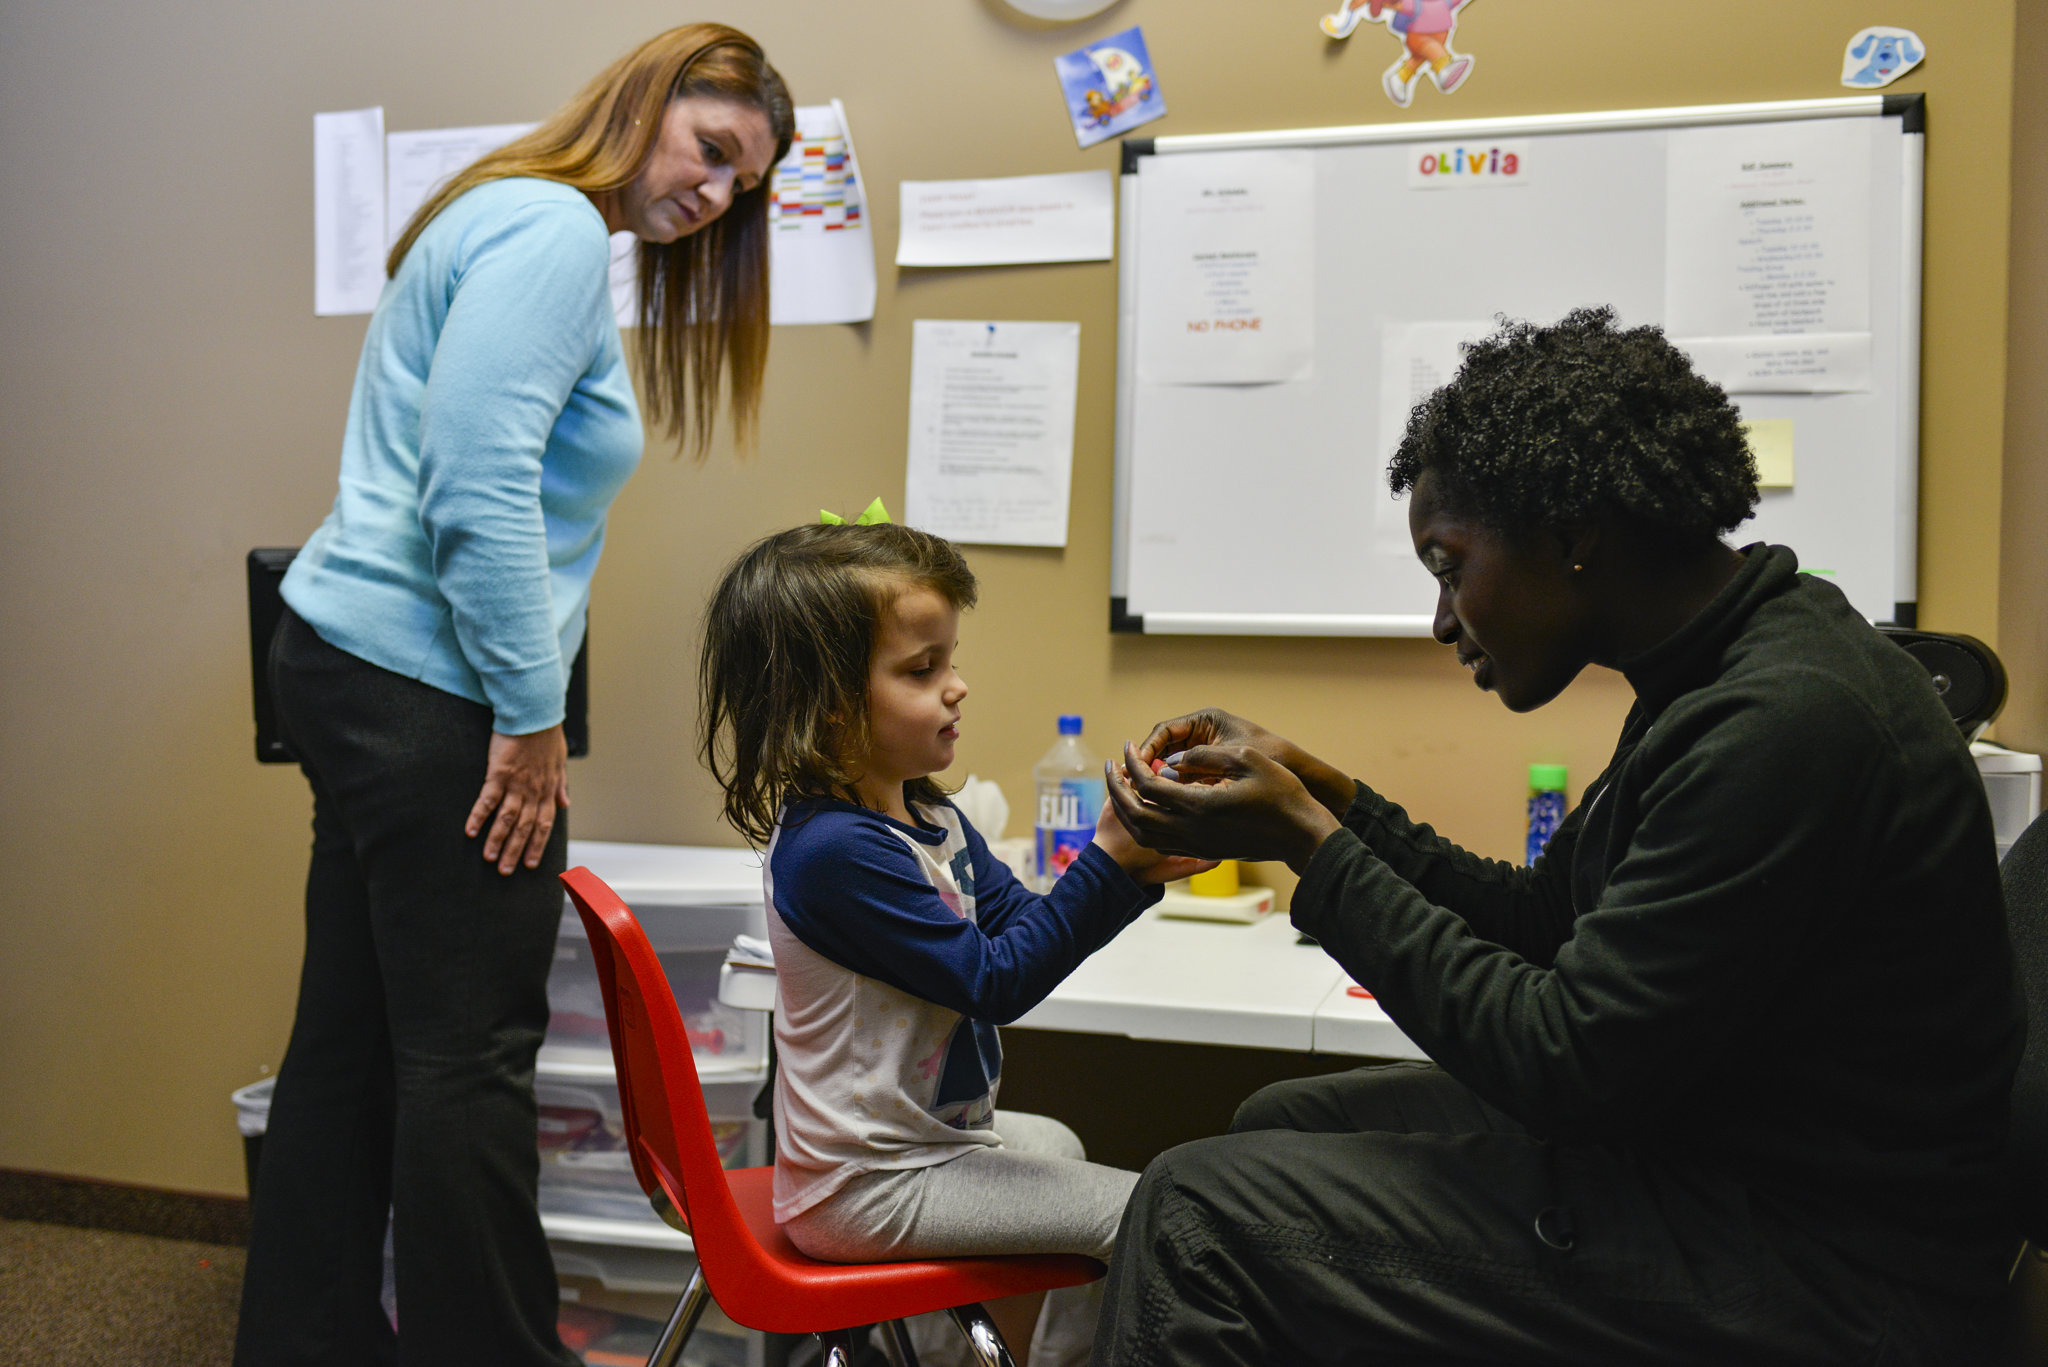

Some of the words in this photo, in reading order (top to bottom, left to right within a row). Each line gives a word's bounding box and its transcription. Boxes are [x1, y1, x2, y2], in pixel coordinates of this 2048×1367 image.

[1186, 321, 1210, 334] NO
[1213, 317, 1263, 332] PHONE
[1040, 794, 1079, 829] FIJI
